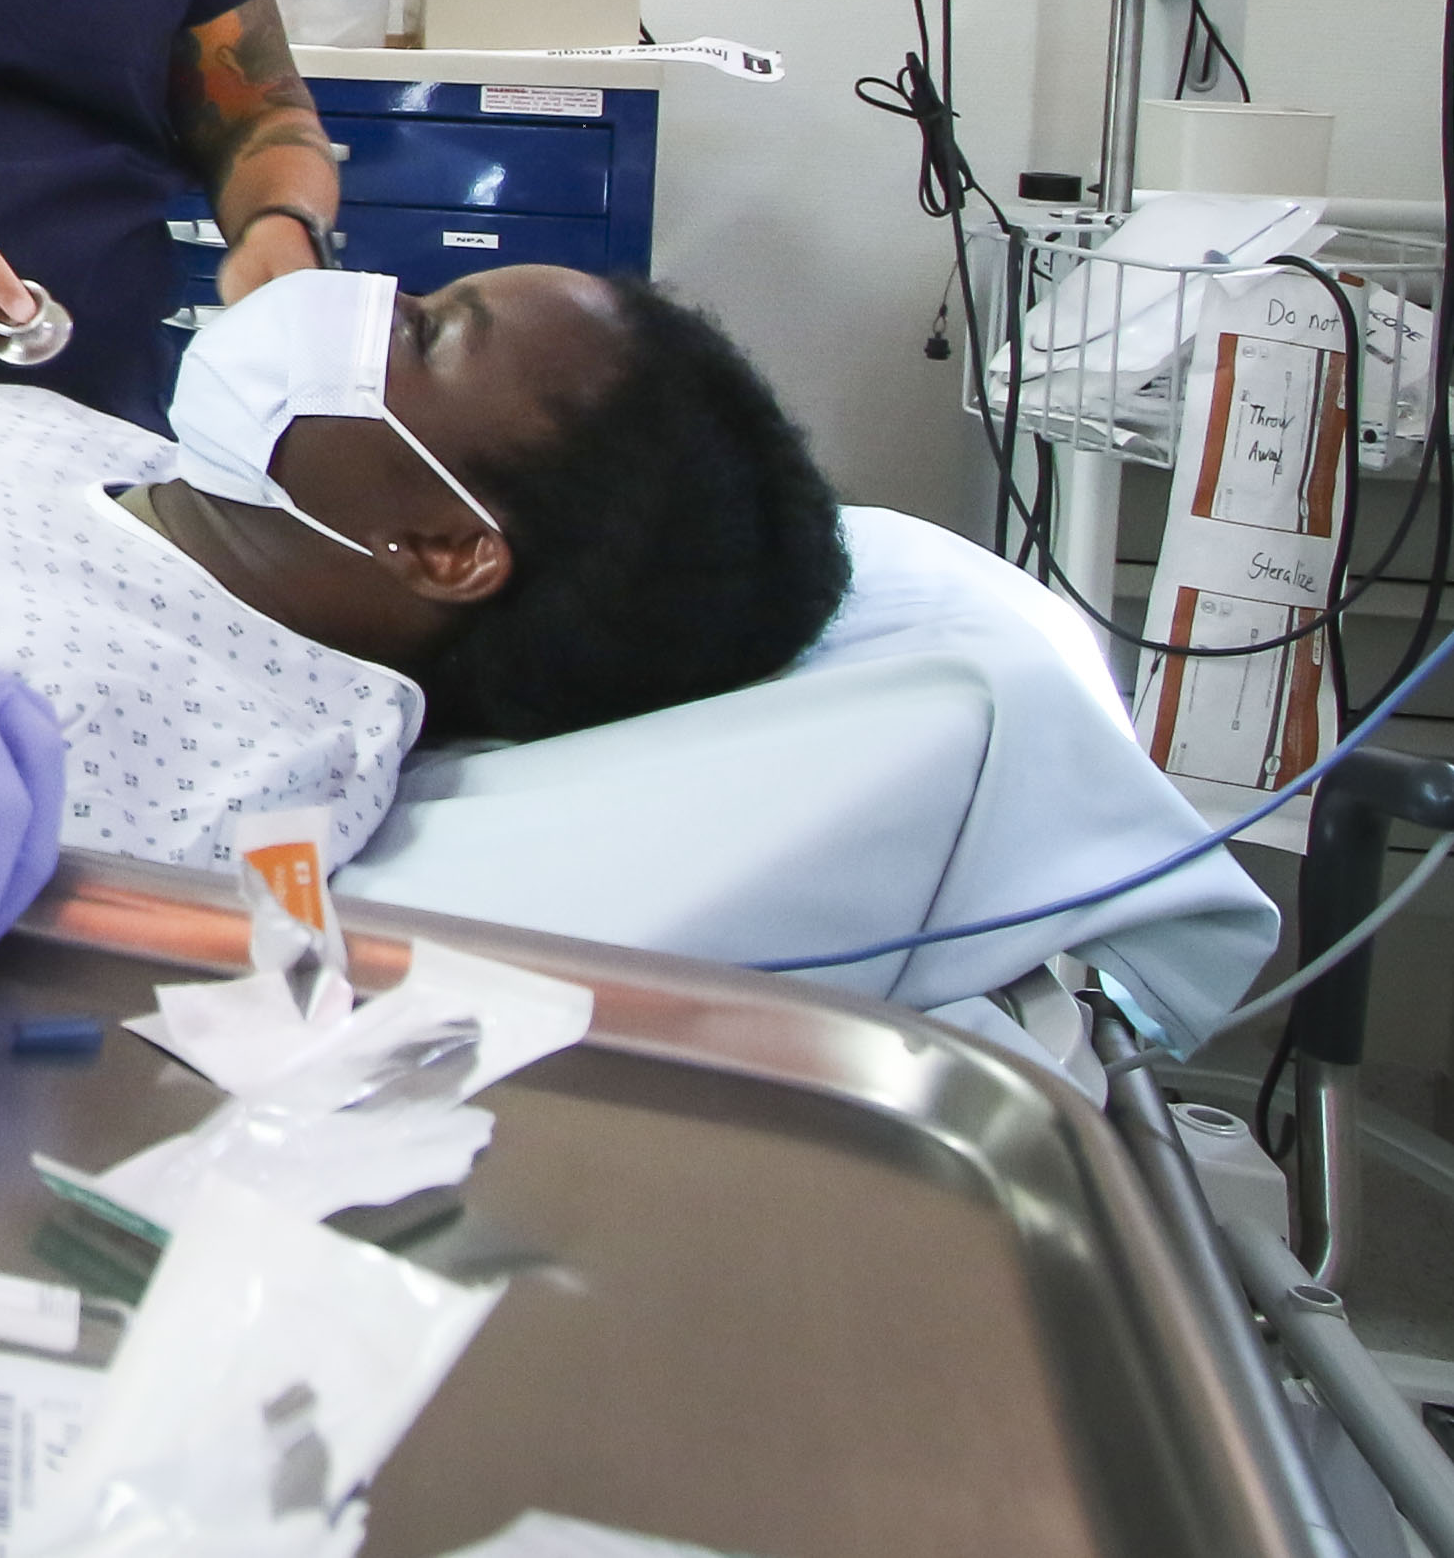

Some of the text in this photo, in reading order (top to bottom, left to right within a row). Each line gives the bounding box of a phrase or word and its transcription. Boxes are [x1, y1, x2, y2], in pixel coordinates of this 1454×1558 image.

[1267, 298, 1341, 331] Do not
[1249, 403, 1296, 430] Throw
[1248, 440, 1283, 486] Away
